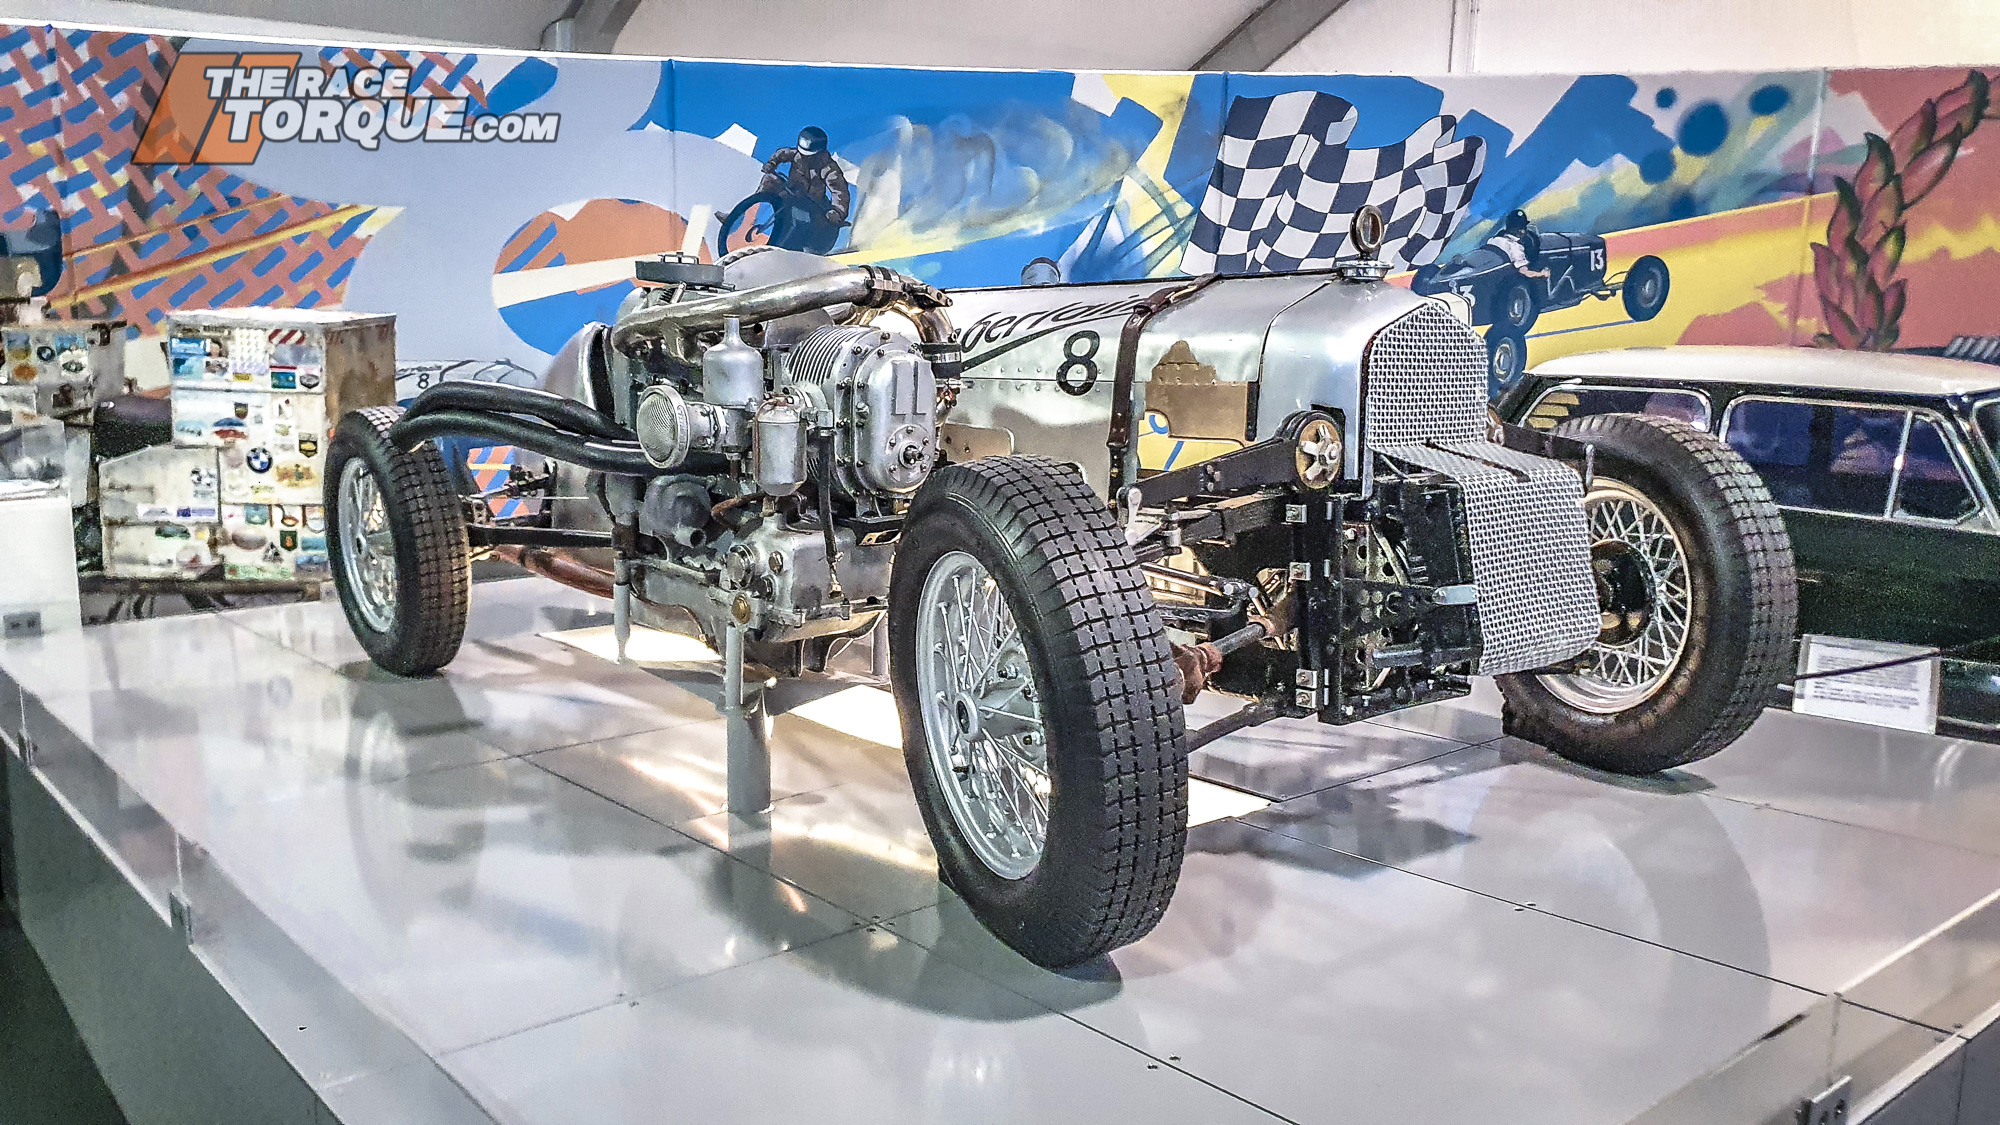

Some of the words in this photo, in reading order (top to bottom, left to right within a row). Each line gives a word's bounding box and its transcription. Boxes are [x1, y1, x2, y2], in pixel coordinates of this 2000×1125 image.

[1590, 248, 1604, 271] 13
[1056, 330, 1100, 396] 8
[418, 373, 430, 389] 8
